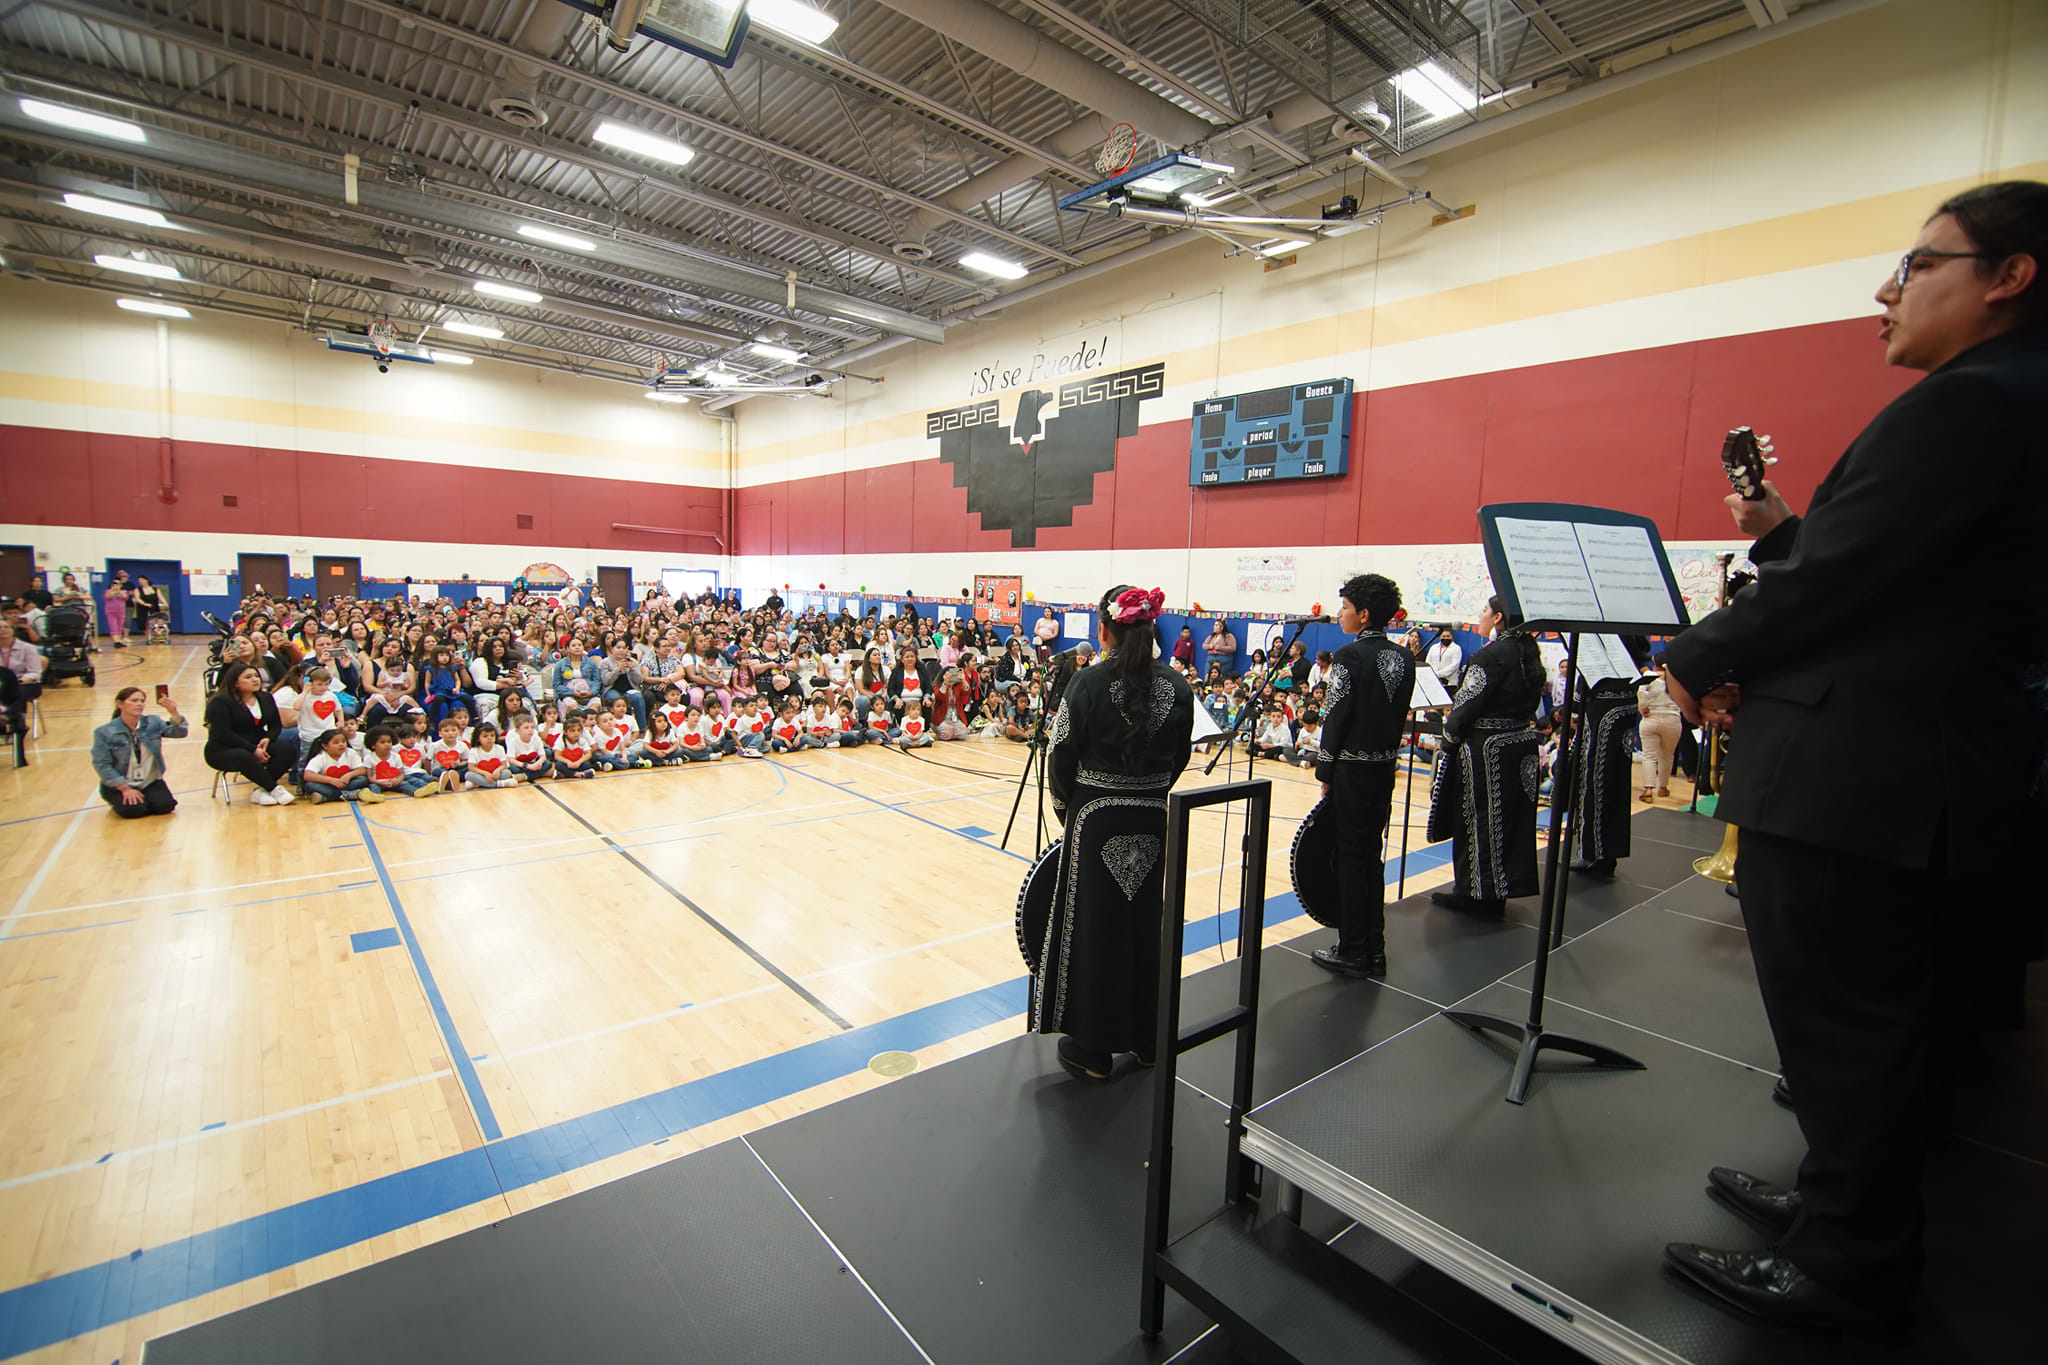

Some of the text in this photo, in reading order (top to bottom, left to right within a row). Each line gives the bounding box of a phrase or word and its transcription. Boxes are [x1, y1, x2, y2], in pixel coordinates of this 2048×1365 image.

[1001, 367, 1021, 389] se
[1028, 335, 1107, 383] Puede!
[1306, 384, 1334, 398] Guests
[1204, 402, 1223, 414] Home
[1249, 429, 1274, 443] period
[1202, 471, 1218, 483] fouls
[1248, 466, 1272, 479] player
